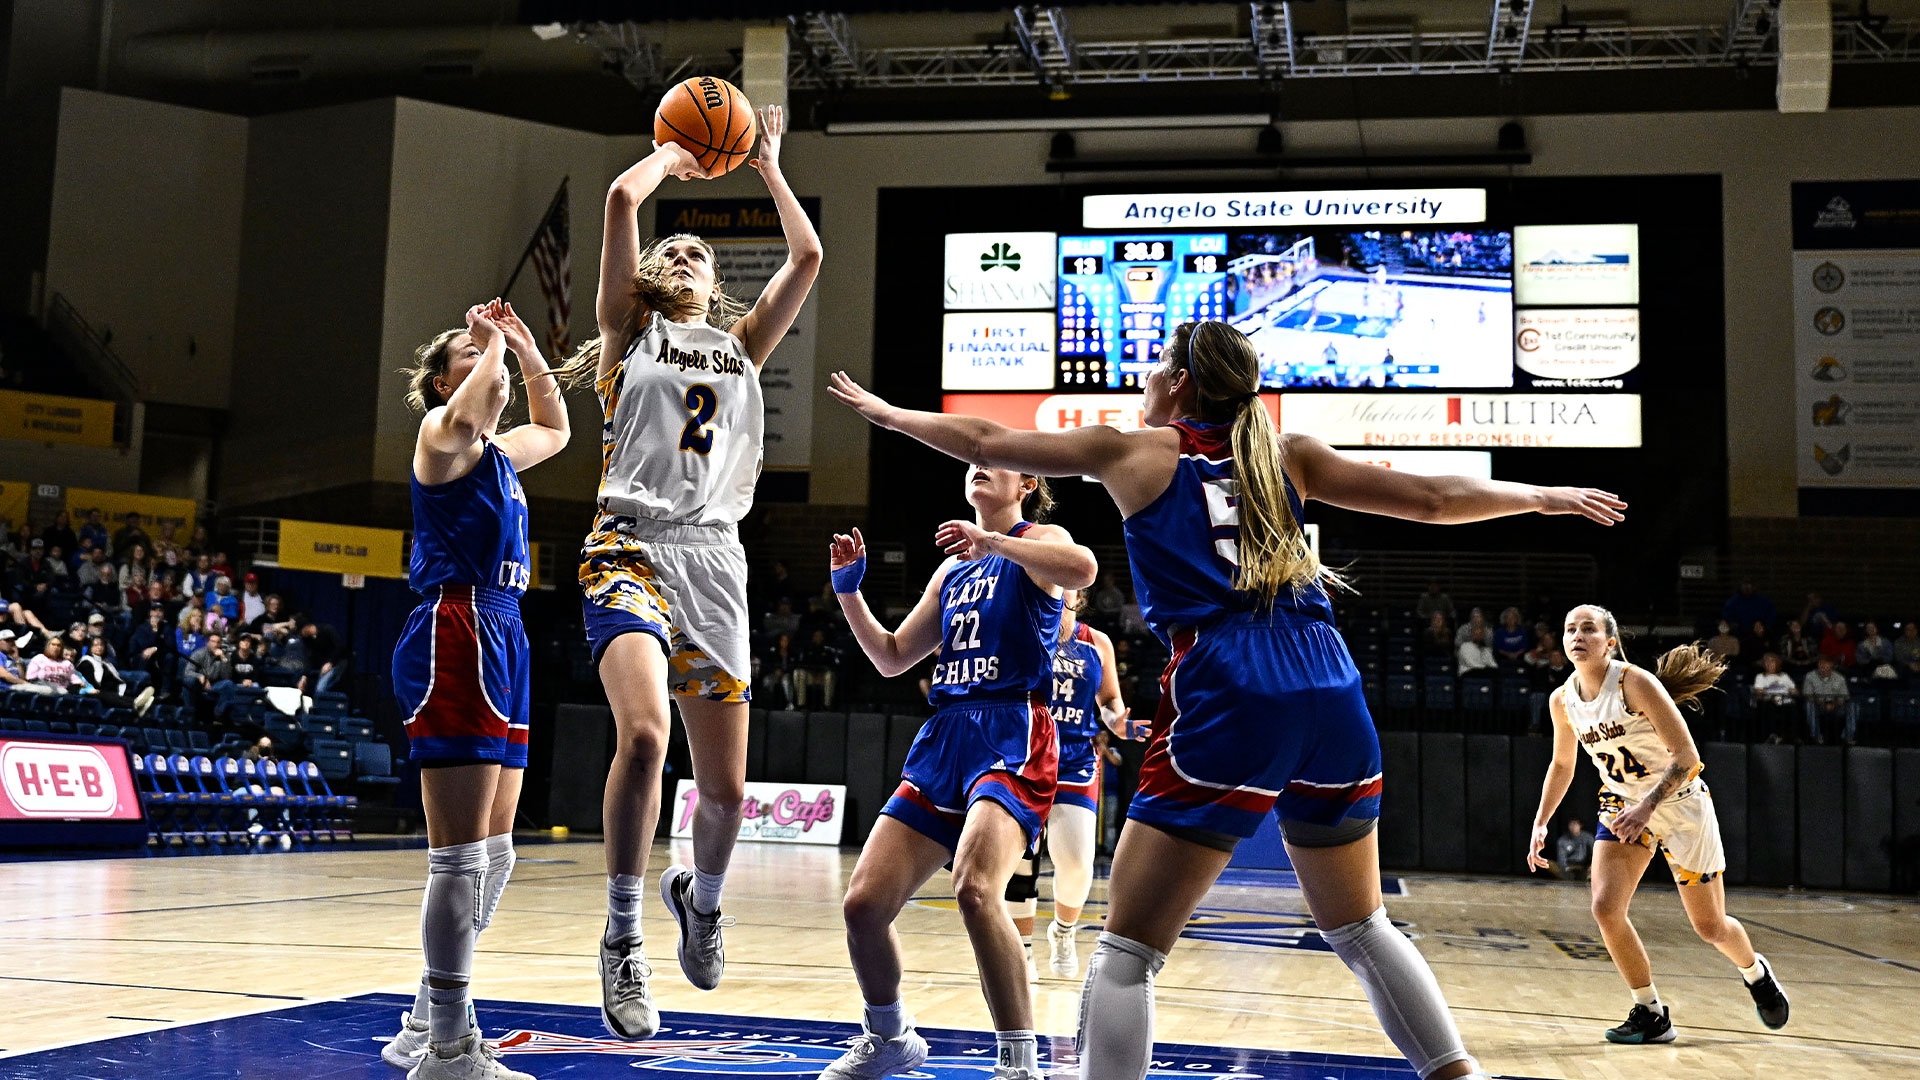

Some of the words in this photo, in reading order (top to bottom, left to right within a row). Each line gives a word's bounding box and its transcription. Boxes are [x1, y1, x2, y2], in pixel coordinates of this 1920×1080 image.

[673, 208, 731, 228] Alma
[735, 208, 780, 228] Mat
[1124, 202, 1217, 224] Angelo
[1227, 200, 1294, 217] State
[1304, 197, 1443, 219] University
[944, 275, 1055, 304] SHANNON
[971, 326, 1027, 339] FIRST
[1564, 330, 1637, 342] Community
[655, 338, 709, 373] Angelo
[947, 341, 1052, 353] FINANCIAL
[971, 356, 1025, 367] BANK
[678, 382, 719, 457] 2
[1471, 400, 1599, 426] ULTRA
[1363, 431, 1421, 445] ENJOY
[1429, 432, 1555, 447] RESPONSIBLY
[313, 541, 341, 554] SAM'S
[344, 545, 368, 557] CLUB
[945, 575, 1000, 610] LADY
[949, 609, 982, 651] 22
[931, 655, 1000, 686] CHAPS
[1052, 656, 1086, 674] ADY
[1049, 706, 1085, 725] APS
[1598, 720, 1627, 742] State
[1595, 745, 1651, 784] 24
